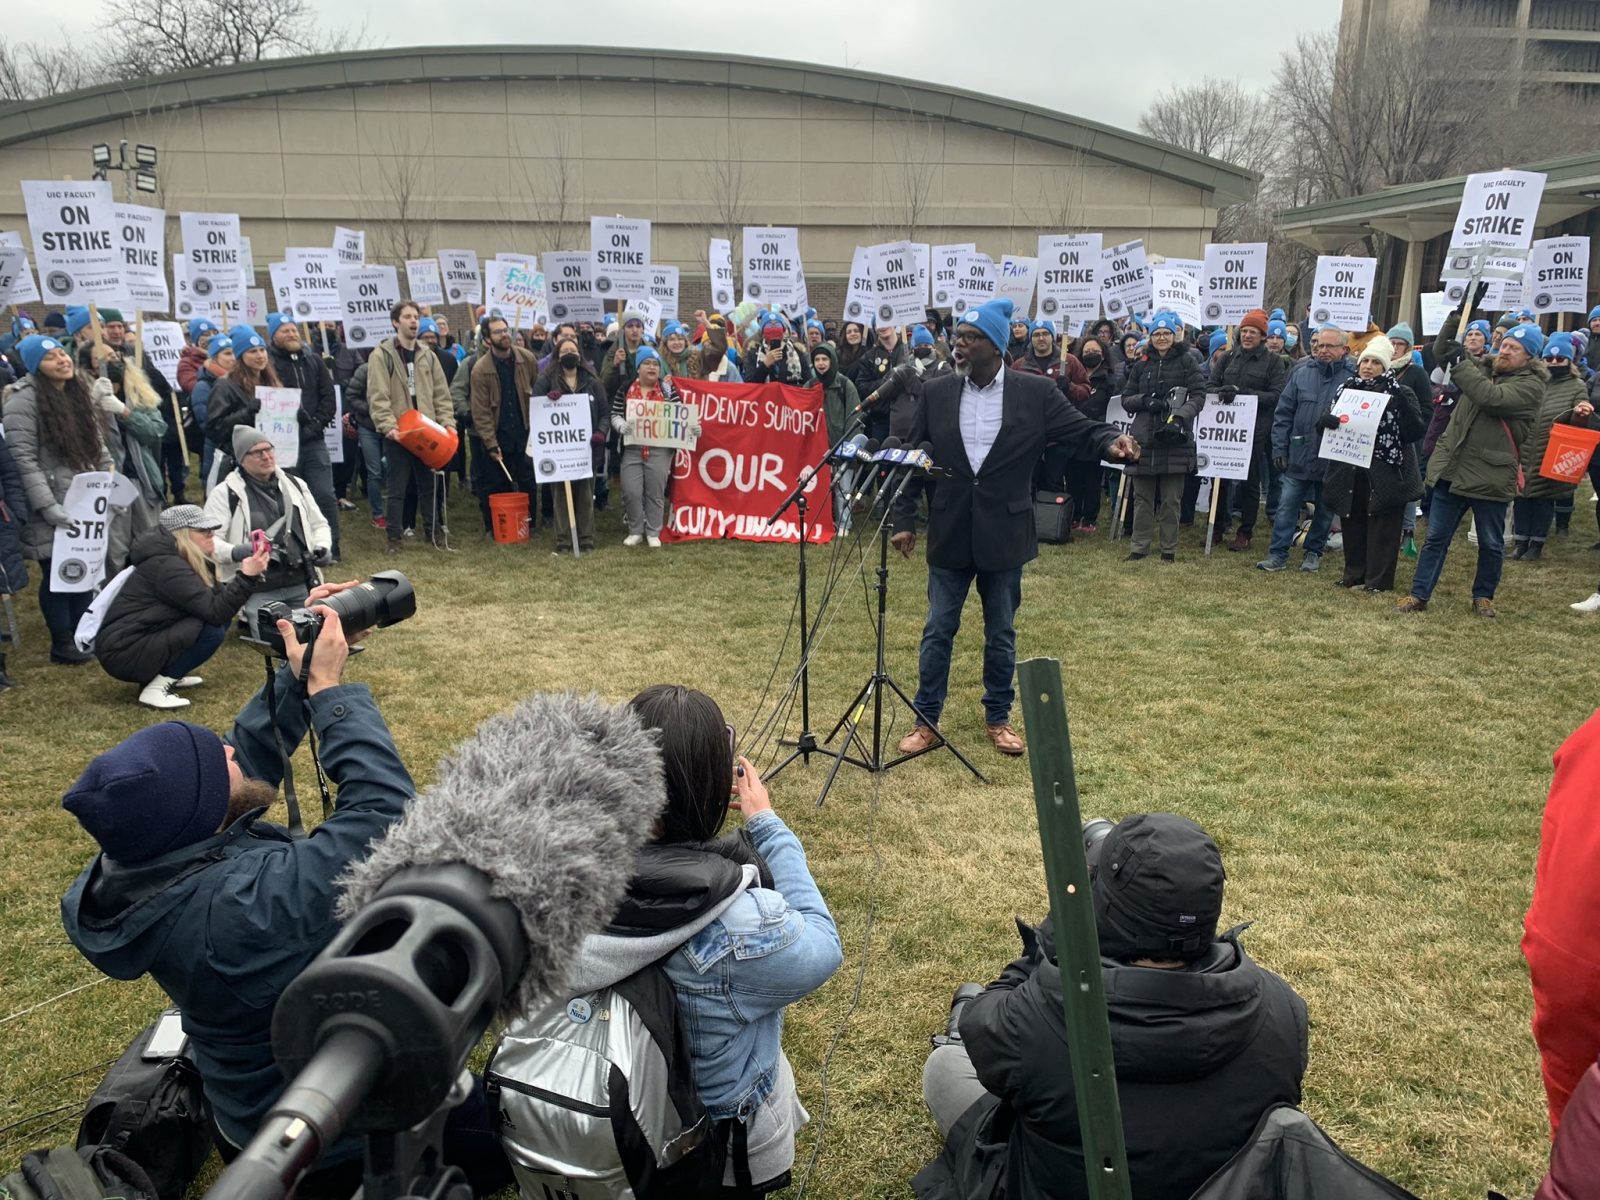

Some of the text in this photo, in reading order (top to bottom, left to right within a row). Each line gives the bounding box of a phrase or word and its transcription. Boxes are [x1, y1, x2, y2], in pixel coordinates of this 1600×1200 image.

[1495, 180, 1526, 188] FACULTY
[46, 191, 96, 199] UIC FACULTY
[1485, 192, 1510, 211] ON
[60, 205, 90, 225] ON
[1462, 215, 1525, 236] STRIKE
[42, 230, 112, 251] STRIKE
[122, 225, 146, 244] ON
[207, 231, 226, 246] ON
[611, 234, 630, 247] ON
[346, 240, 359, 250] ON
[761, 242, 779, 255] ON
[120, 247, 158, 267] RIKE
[192, 249, 237, 264] STRIKE
[597, 250, 644, 265] STRIKE
[1059, 251, 1079, 266] ON
[1113, 248, 1133, 257] FACULTY
[1553, 252, 1573, 265] ON
[305, 262, 323, 274] ON
[453, 260, 466, 269] ON
[749, 258, 791, 271] STRIKE
[886, 258, 903, 273] ON
[1112, 257, 1129, 272] ON
[1224, 260, 1244, 273] ON
[1473, 259, 1517, 268] Lal 6456
[447, 272, 477, 281] STRIKE
[563, 265, 582, 278] ON
[937, 270, 955, 281] STR
[970, 265, 984, 277] ON
[1044, 269, 1094, 284] STRIKE
[1334, 271, 1354, 283] ON
[1537, 267, 1584, 282] STRIKE
[79, 279, 101, 287] Local
[294, 278, 337, 289] STRIKE
[653, 276, 666, 285] ON
[853, 277, 872, 292] STR
[876, 274, 917, 292] STRIKE
[958, 278, 994, 292] STRIKE
[1103, 268, 1145, 290] STRIKE
[1171, 280, 1187, 290] ON
[1209, 276, 1258, 290] STRIKE
[359, 283, 378, 297] ON
[650, 286, 674, 297] TRIKE
[1319, 285, 1366, 300] STRIKE
[1124, 297, 1137, 305] Local
[1159, 289, 1196, 306] STRIKE
[347, 299, 394, 314] STRIKE
[638, 302, 650, 313] ON
[153, 334, 170, 346] ON
[146, 348, 182, 361] TRIK
[628, 400, 689, 418] POWER TO
[680, 389, 759, 427] TUDENTS
[550, 412, 570, 426] ON
[1215, 410, 1236, 425] ON
[635, 417, 688, 441] FACULTY
[1198, 427, 1248, 443] STRIKE
[537, 429, 587, 445] STRIKE
[698, 448, 787, 493] OUR
[94, 496, 107, 515] O
[668, 505, 736, 537] CULTY
[66, 520, 105, 539] STR
[570, 1008, 587, 1020] Nina
